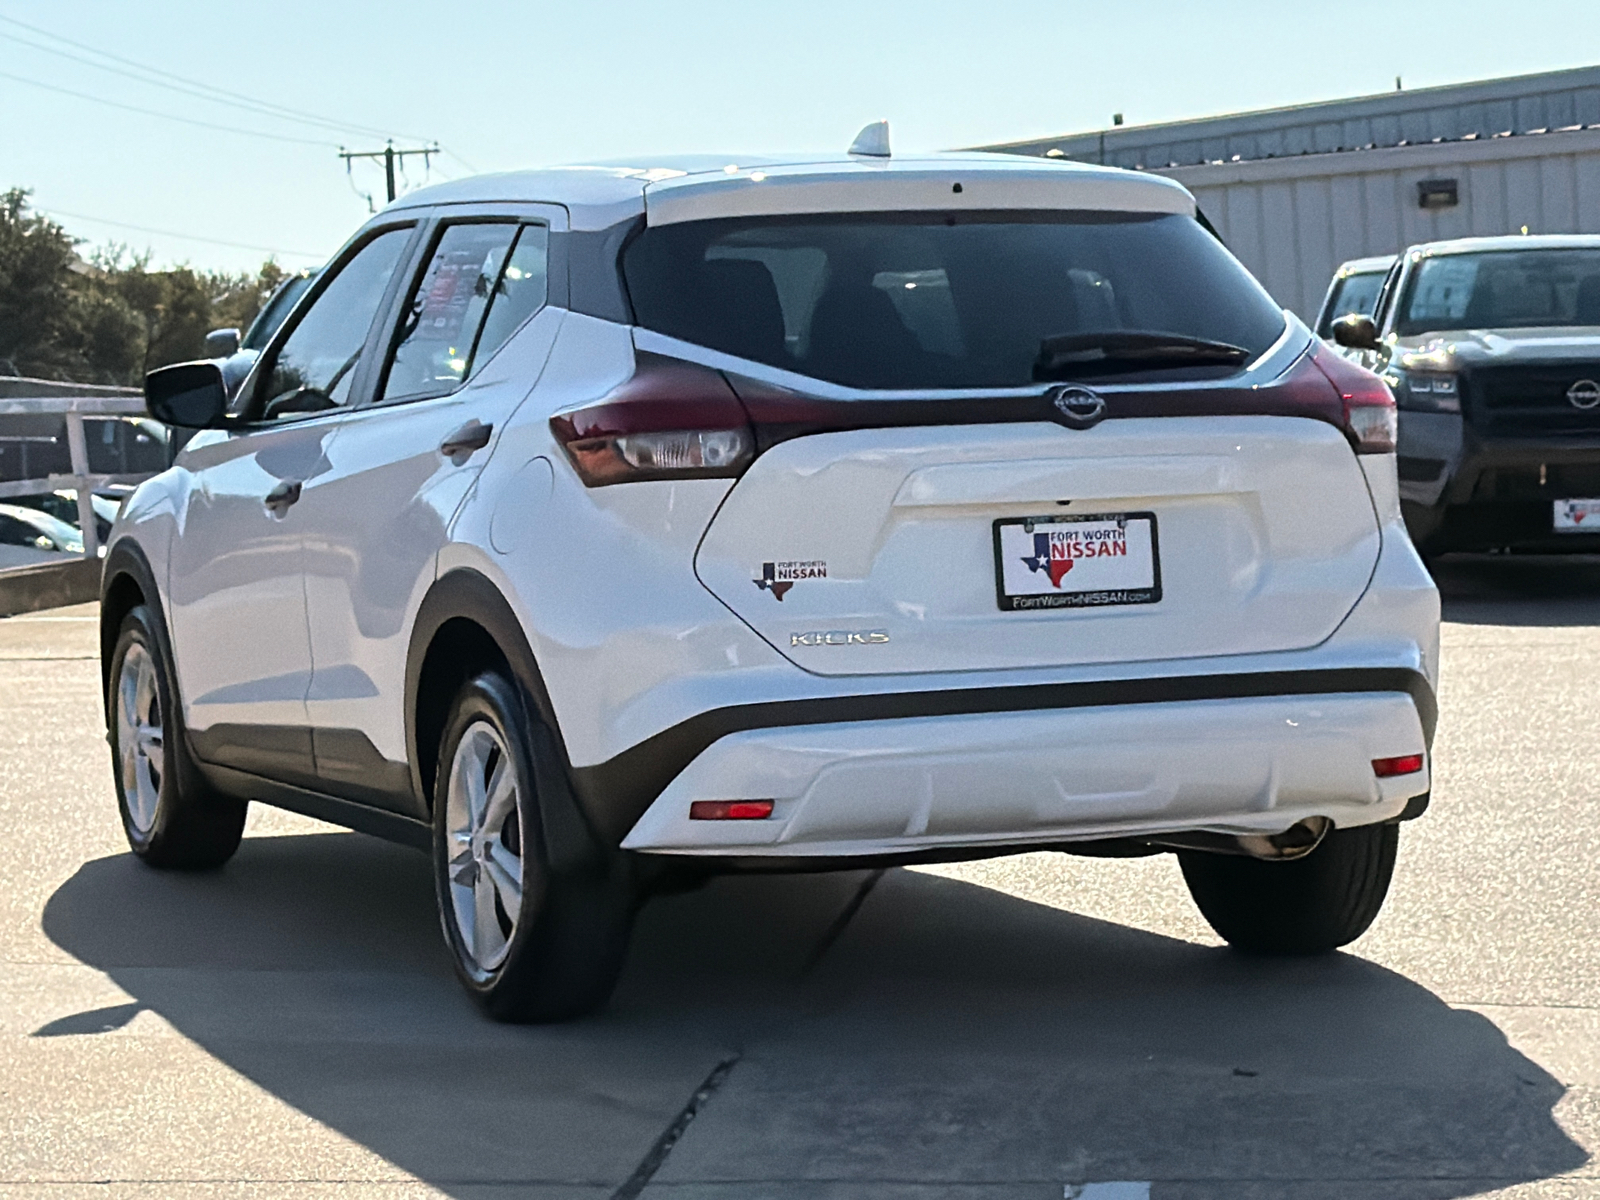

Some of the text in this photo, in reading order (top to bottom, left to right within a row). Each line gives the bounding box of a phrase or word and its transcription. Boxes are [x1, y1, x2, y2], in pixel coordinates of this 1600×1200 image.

[1050, 529, 1125, 542] FORT WORTH
[1051, 540, 1127, 559] NISSAN
[778, 568, 827, 580] NISSAN
[789, 629, 890, 647] KICKS
